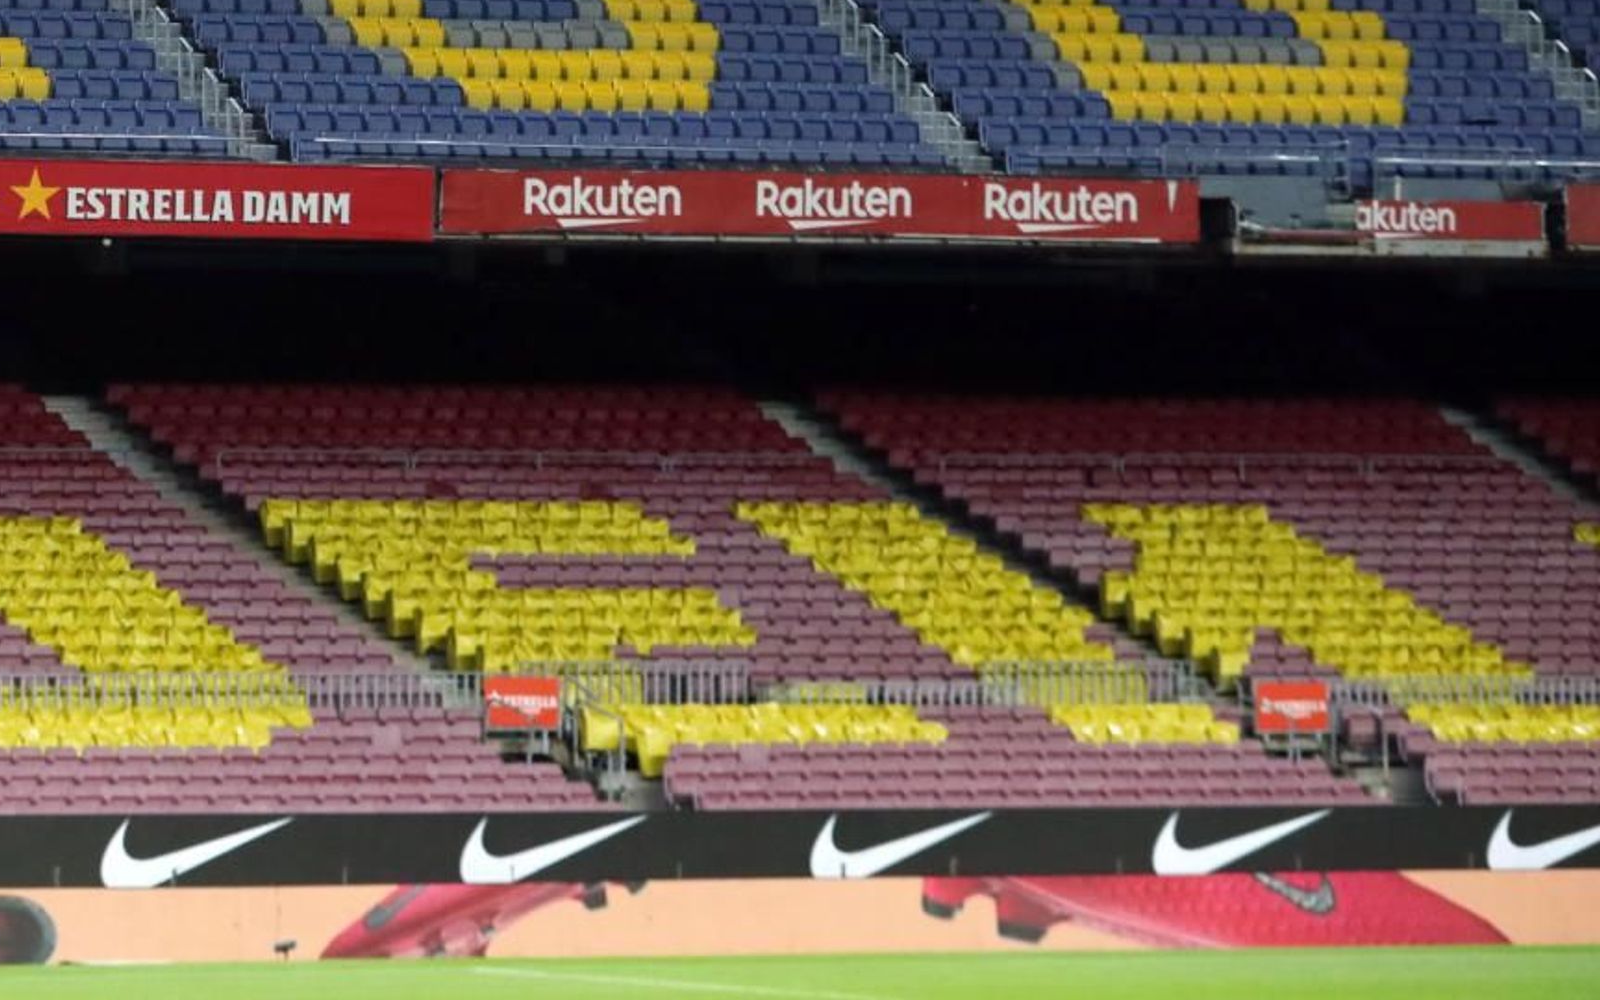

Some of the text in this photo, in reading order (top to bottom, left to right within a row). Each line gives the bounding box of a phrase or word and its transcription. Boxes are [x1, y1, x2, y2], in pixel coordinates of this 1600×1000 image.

[66, 187, 351, 224] ESTRELLA DAMM
[524, 176, 682, 216] Rakuten
[756, 179, 912, 218] Rakuten
[984, 182, 1138, 222] Rakuten
